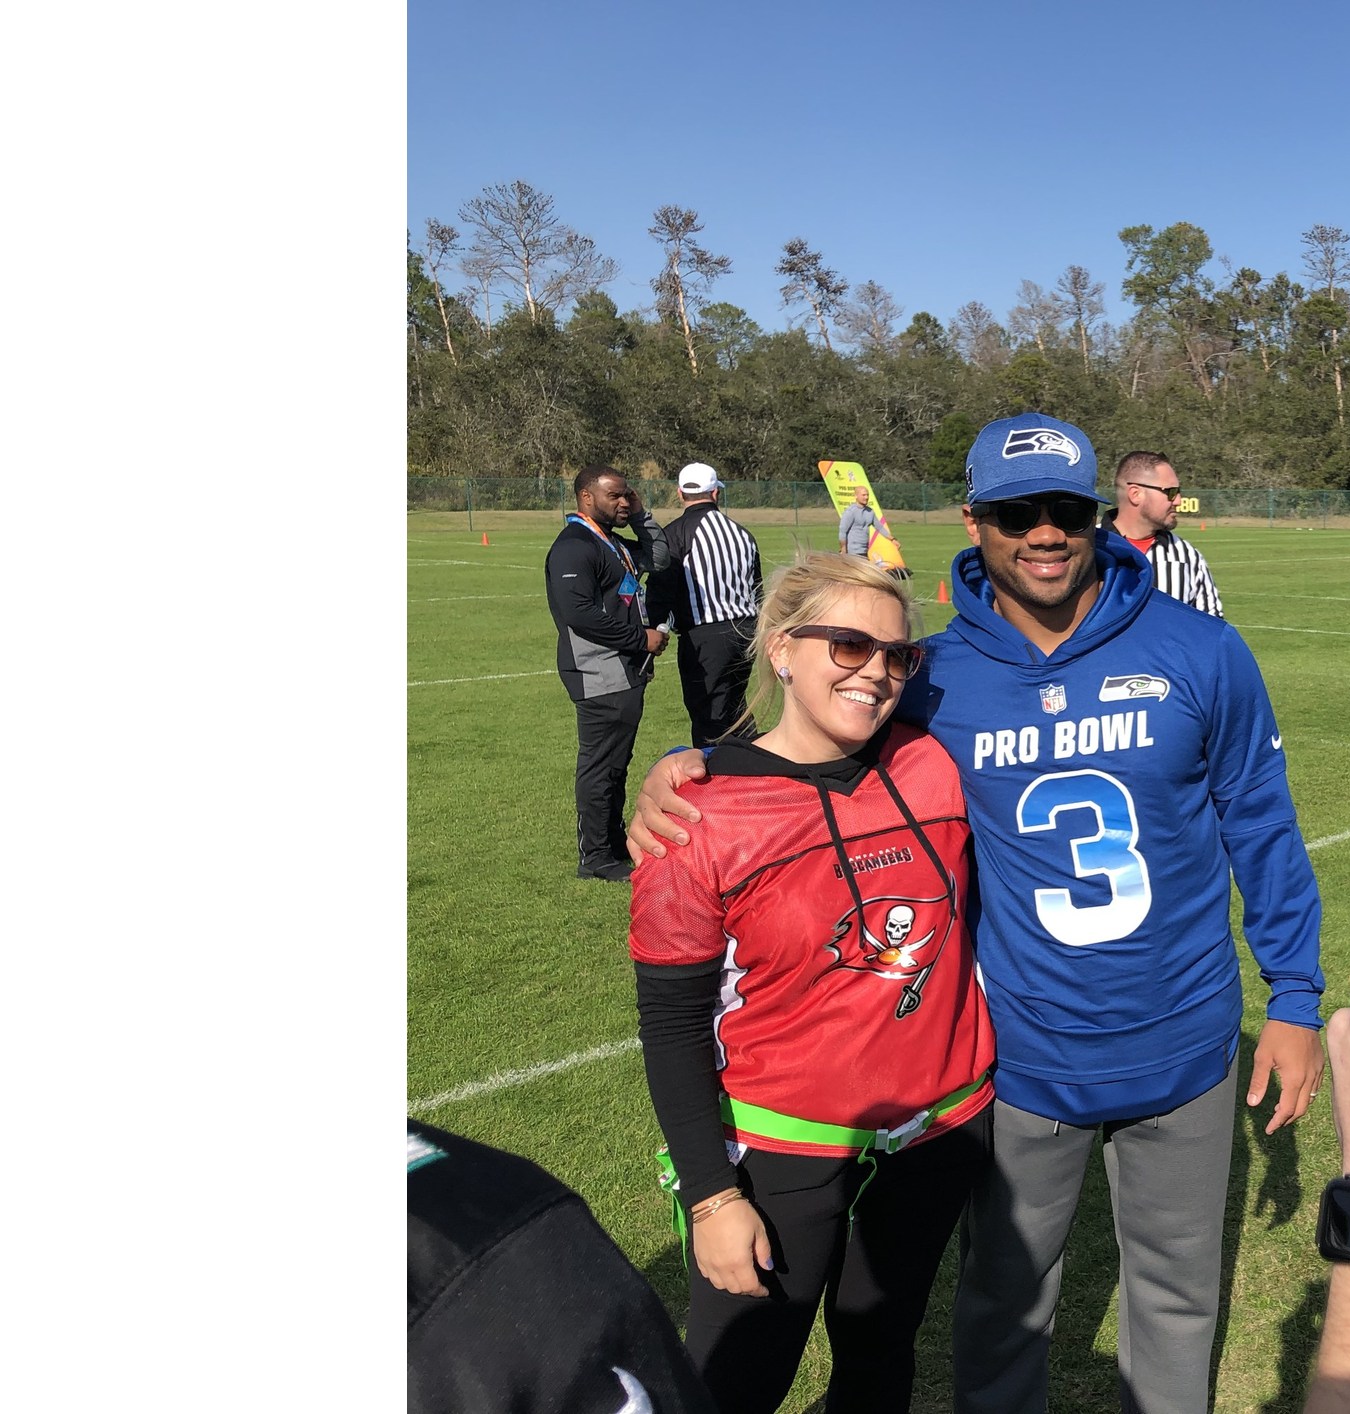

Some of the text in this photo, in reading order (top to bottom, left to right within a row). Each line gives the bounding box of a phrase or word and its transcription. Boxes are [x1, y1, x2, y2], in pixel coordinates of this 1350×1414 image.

[1042, 697, 1064, 710] NFL
[974, 710, 1154, 769] PRO BOWL
[833, 847, 914, 880] BCCANEERS
[848, 846, 896, 863] AMPA BAY
[1016, 768, 1152, 947] 3
